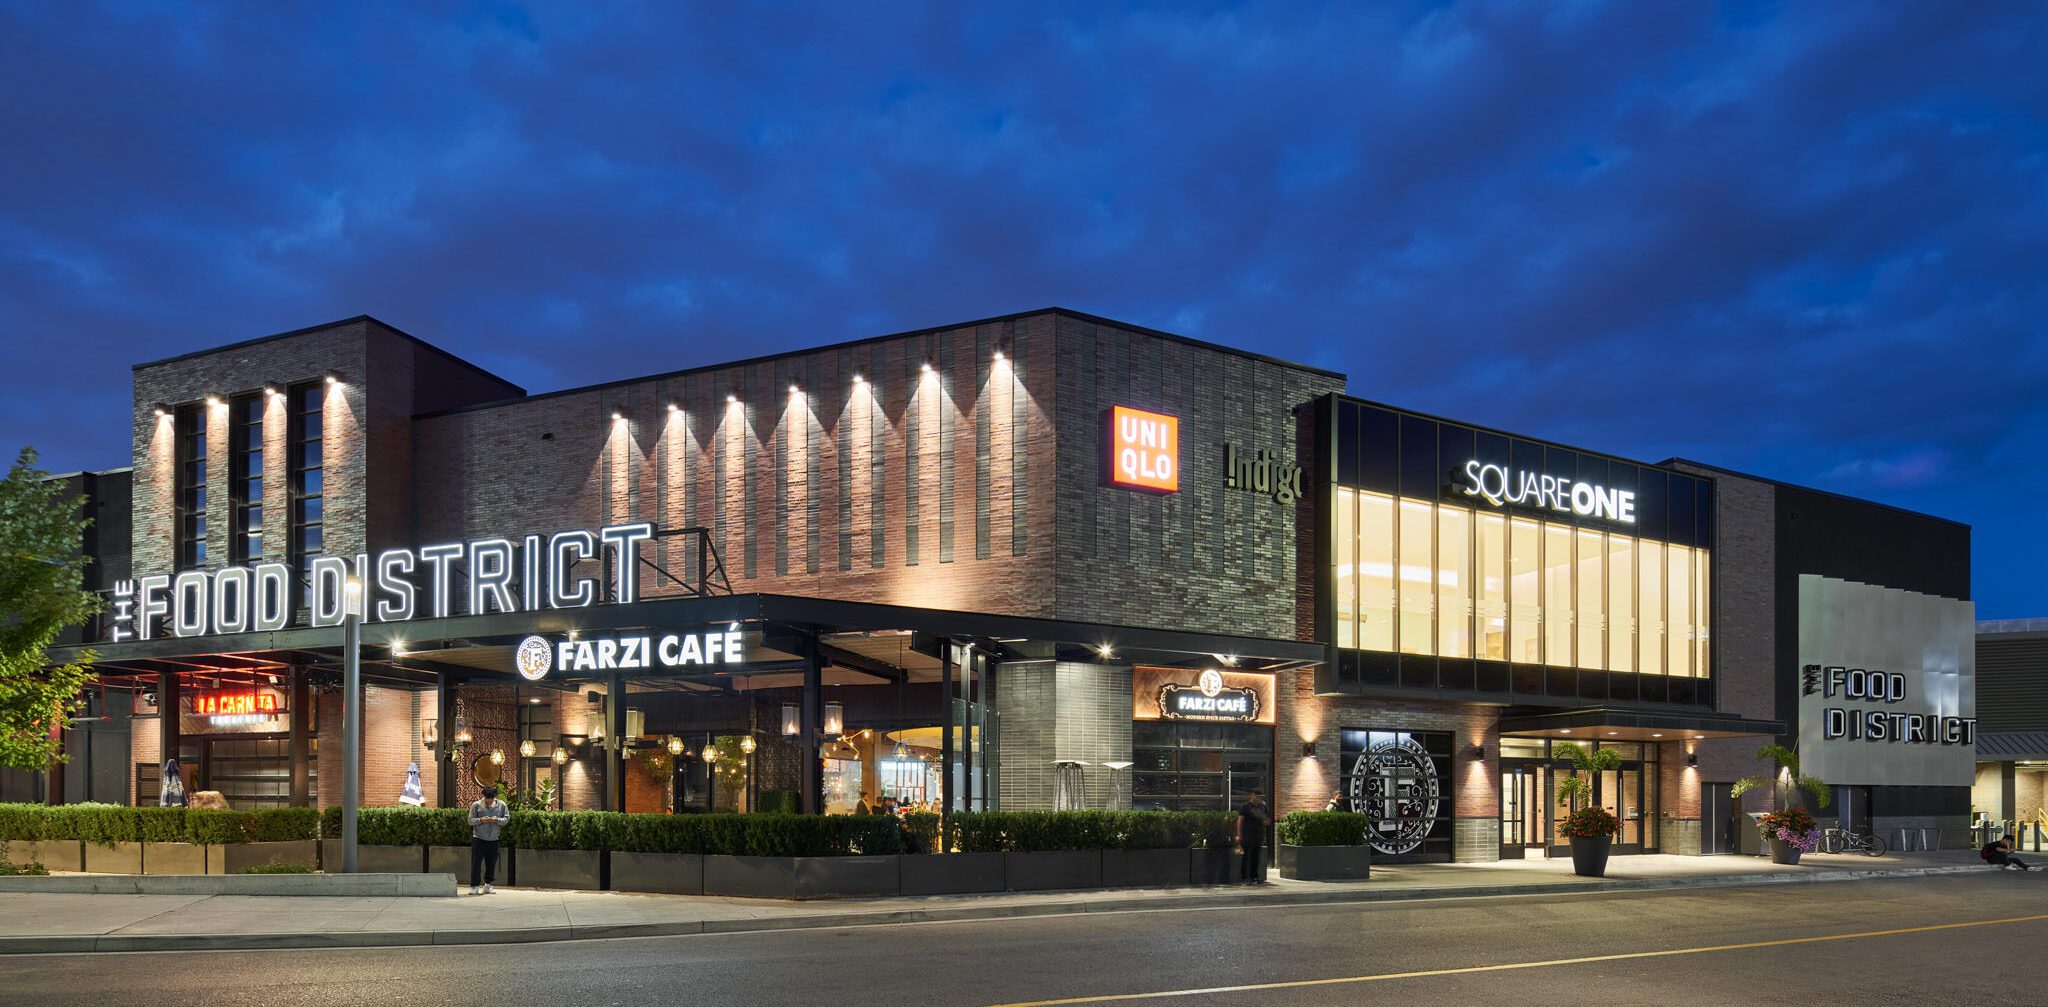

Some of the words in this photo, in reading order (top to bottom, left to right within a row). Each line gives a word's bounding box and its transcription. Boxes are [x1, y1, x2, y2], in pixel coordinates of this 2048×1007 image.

[1121, 416, 1168, 449] UNI
[1121, 448, 1171, 480] QLO
[1464, 460, 1635, 523] SQUAREONE
[139, 562, 291, 640] FOOD
[312, 522, 652, 627] DISTRICT
[114, 579, 134, 642] THE
[558, 637, 650, 671] FARZI
[658, 622, 743, 667] CAFÉ
[1827, 667, 1905, 702] FOOD
[220, 694, 274, 714] CARNTA
[1179, 697, 1215, 711] FARZI
[1216, 697, 1247, 712] CAFÉ
[1827, 708, 1976, 744] DISTRICT
